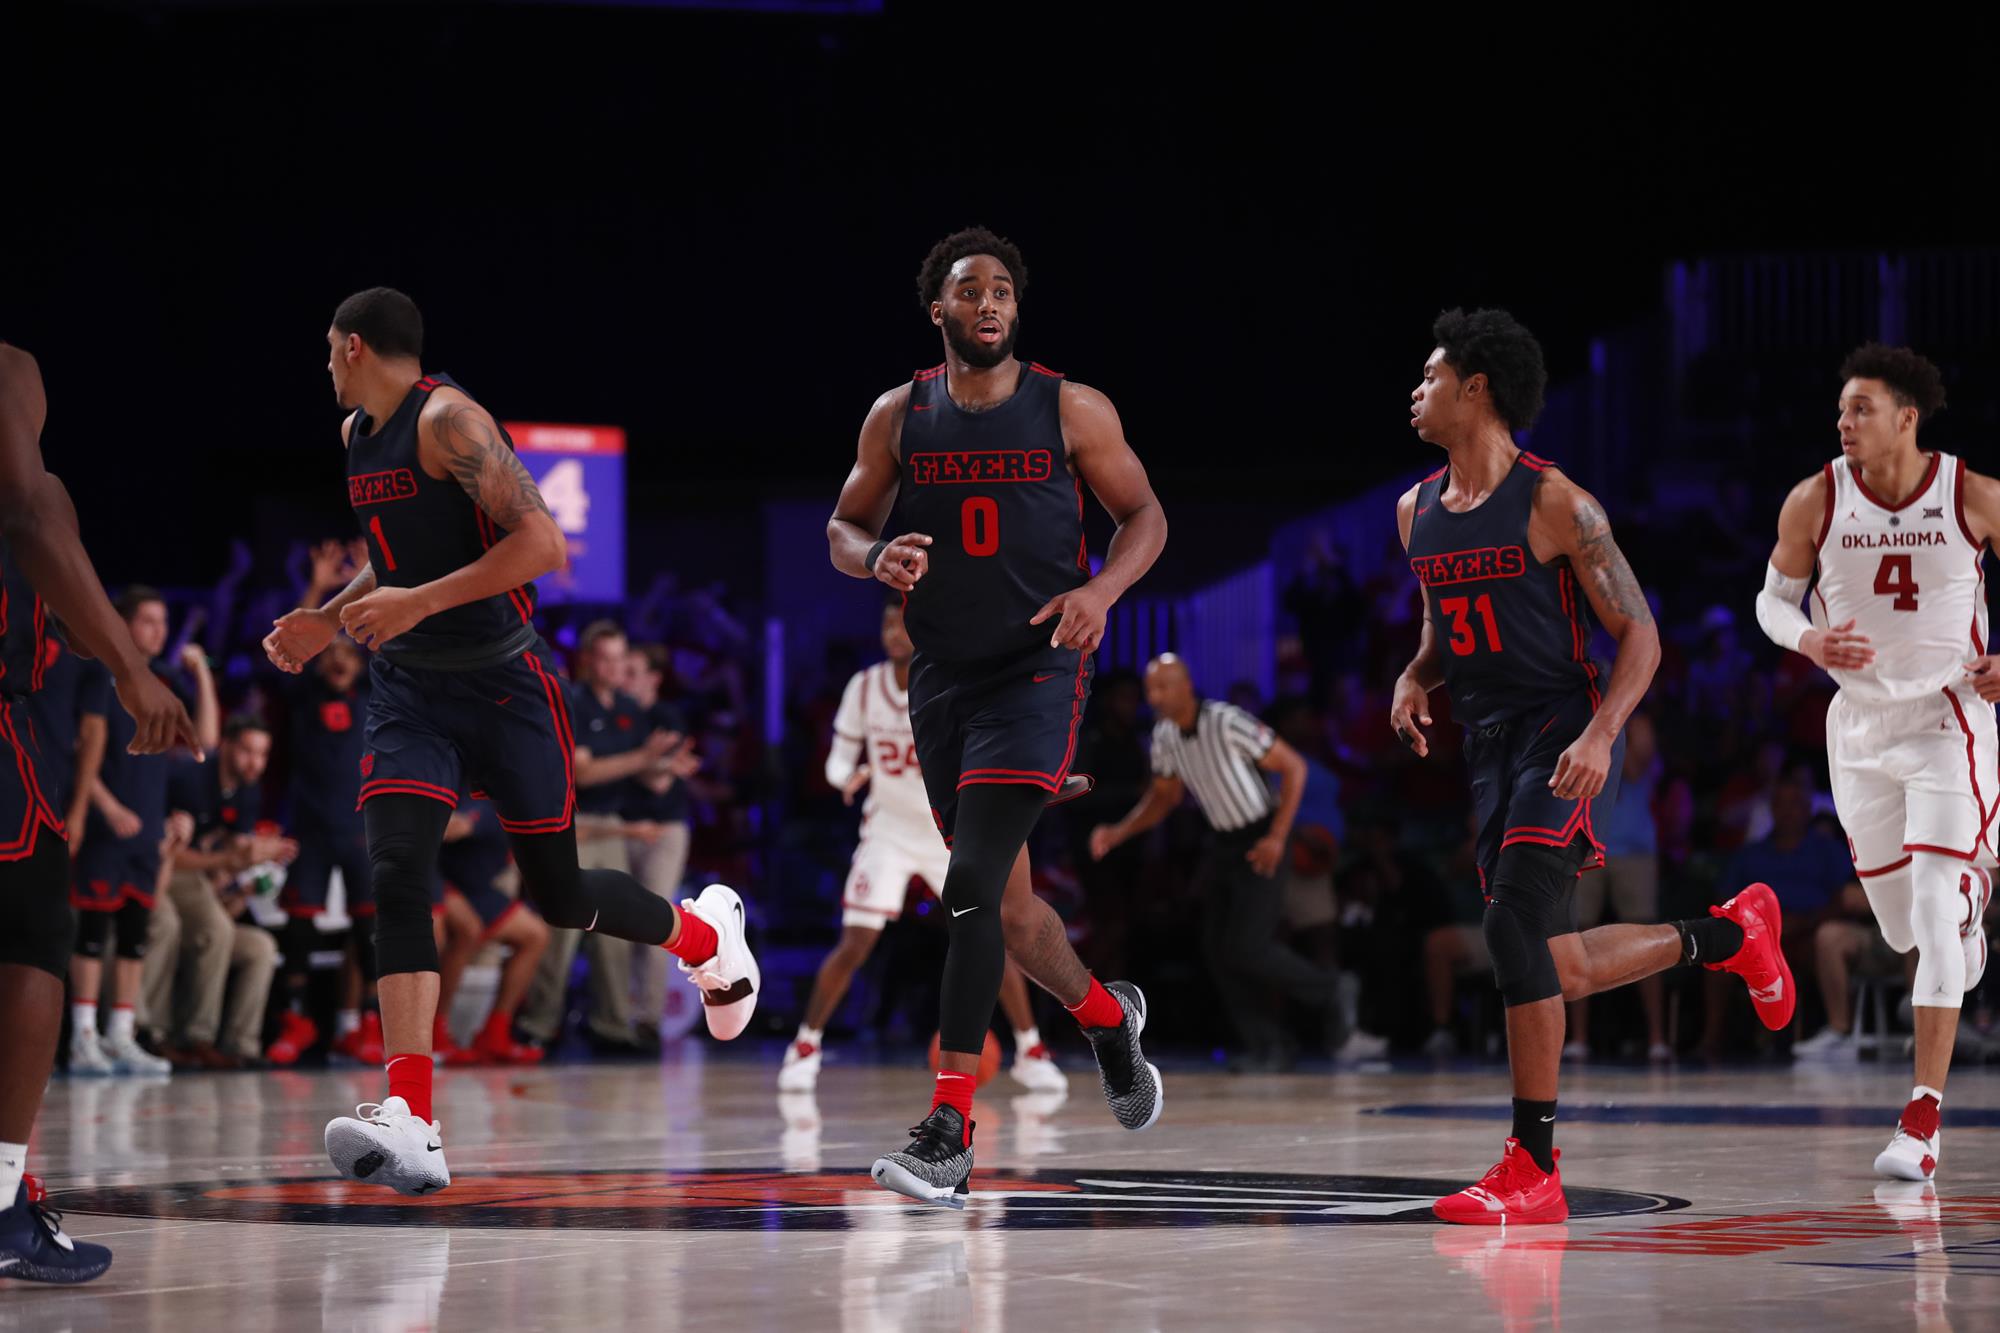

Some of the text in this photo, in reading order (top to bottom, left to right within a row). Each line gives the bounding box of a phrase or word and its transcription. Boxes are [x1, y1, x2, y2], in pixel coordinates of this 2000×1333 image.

[910, 449, 1052, 485] FLYERS
[369, 515, 397, 572] 1
[961, 496, 1000, 557] 0
[1842, 531, 1947, 549] OKLAHOMA
[1410, 545, 1526, 587] FLYERS
[1873, 554, 1919, 612] 4
[1440, 593, 1503, 656] 31
